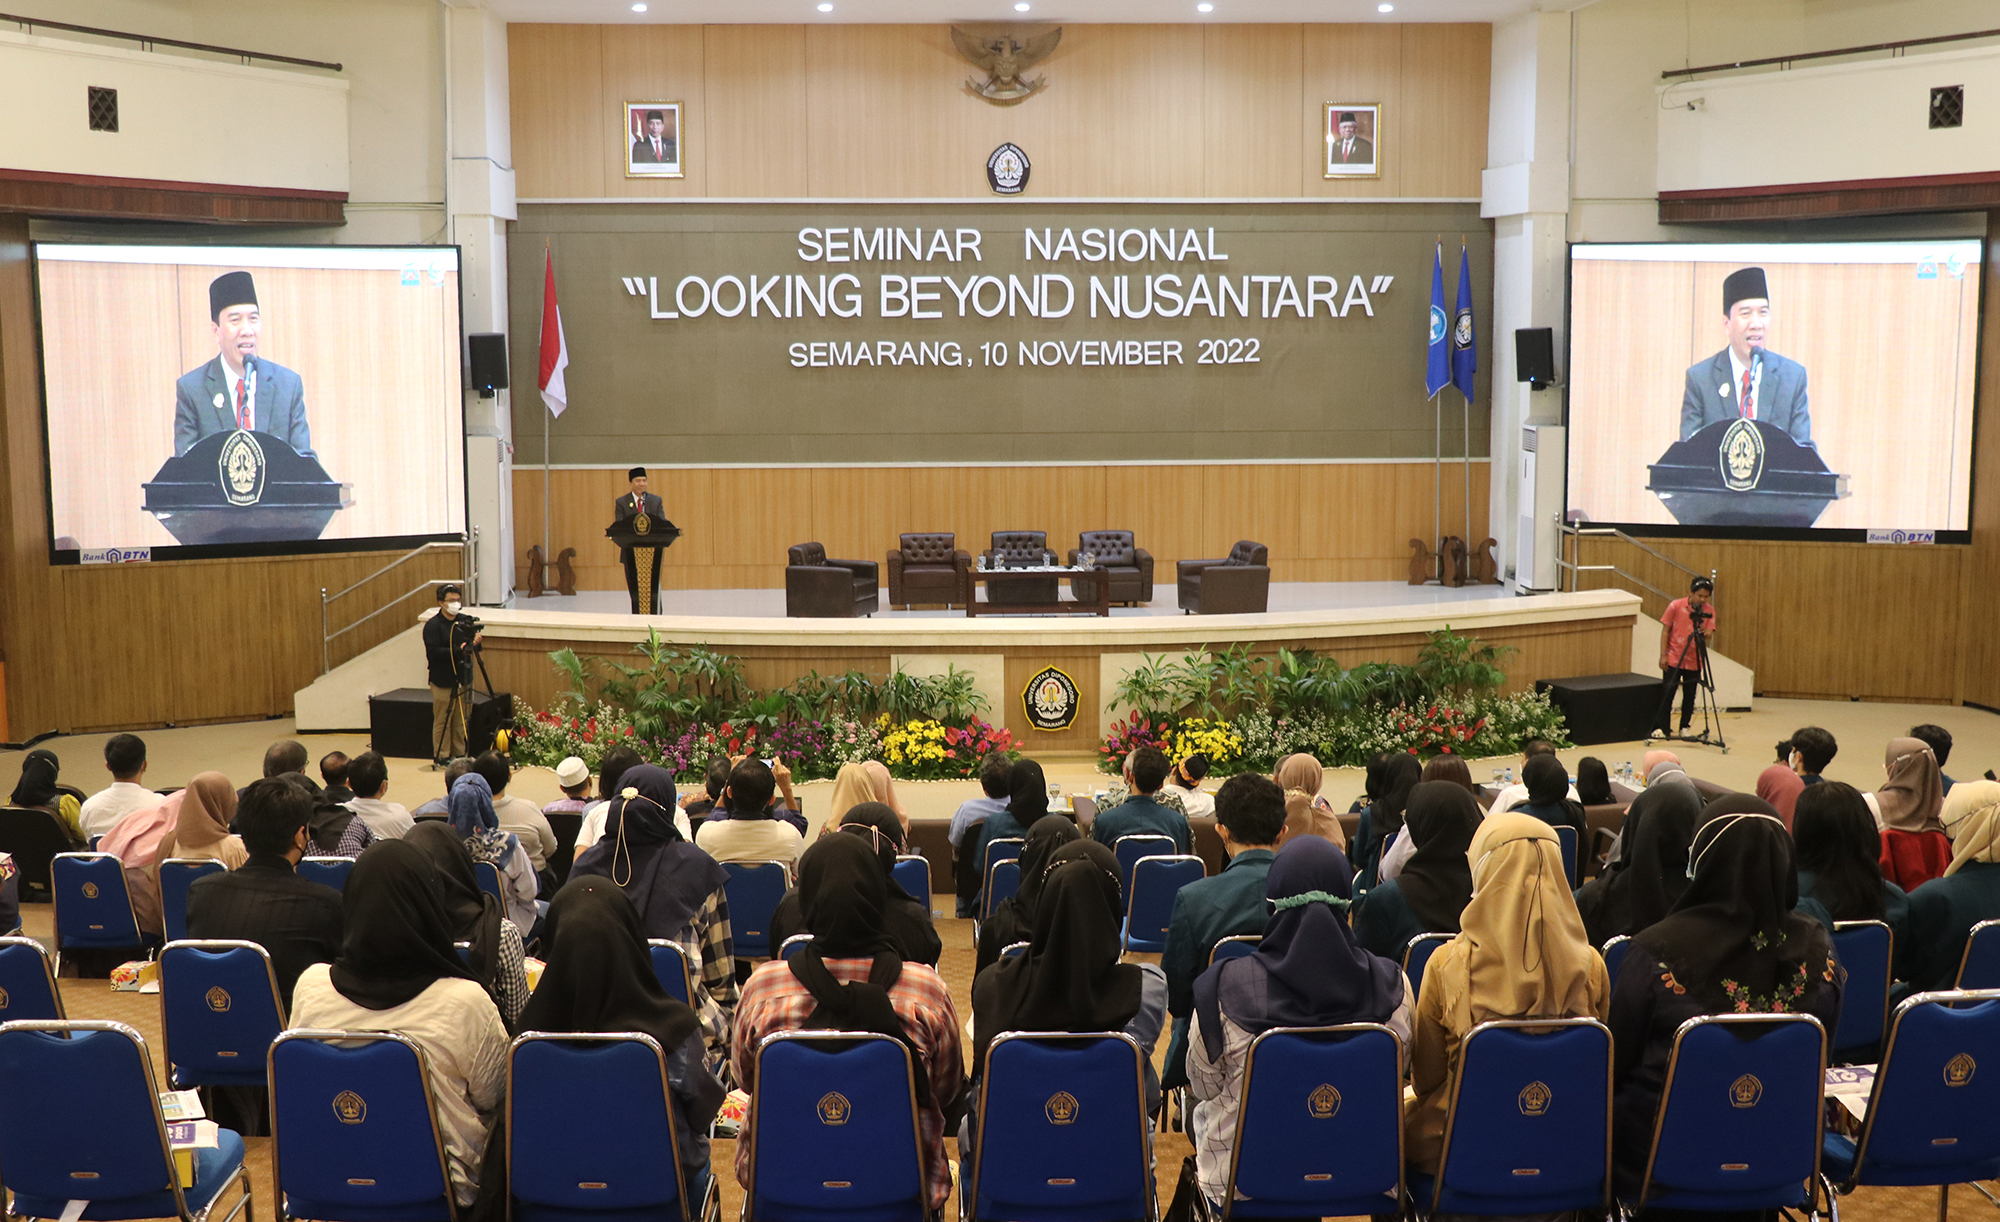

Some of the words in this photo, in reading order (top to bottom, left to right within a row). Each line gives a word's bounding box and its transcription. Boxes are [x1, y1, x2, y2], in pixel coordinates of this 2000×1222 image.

[797, 227, 982, 263] SEMINAR
[1025, 226, 1229, 263] NASIONAL
[621, 273, 862, 319] "LOOKING
[880, 273, 1075, 319] BEYOND
[1089, 273, 1395, 319] NUSANTARA"
[788, 341, 973, 368] SEMARANG,
[980, 341, 1008, 367] 10
[1018, 340, 1184, 366] NOVEMBER
[1197, 337, 1261, 365] 2022
[1869, 533, 1890, 541] Bank
[1907, 533, 1934, 541] BTN
[82, 553, 106, 561] Bank
[123, 551, 149, 560] BTN
[1028, 672, 1049, 704] UNIVERSITAS
[1050, 672, 1075, 704] DIPONEGORO
[1036, 719, 1066, 728] SEMARANG
